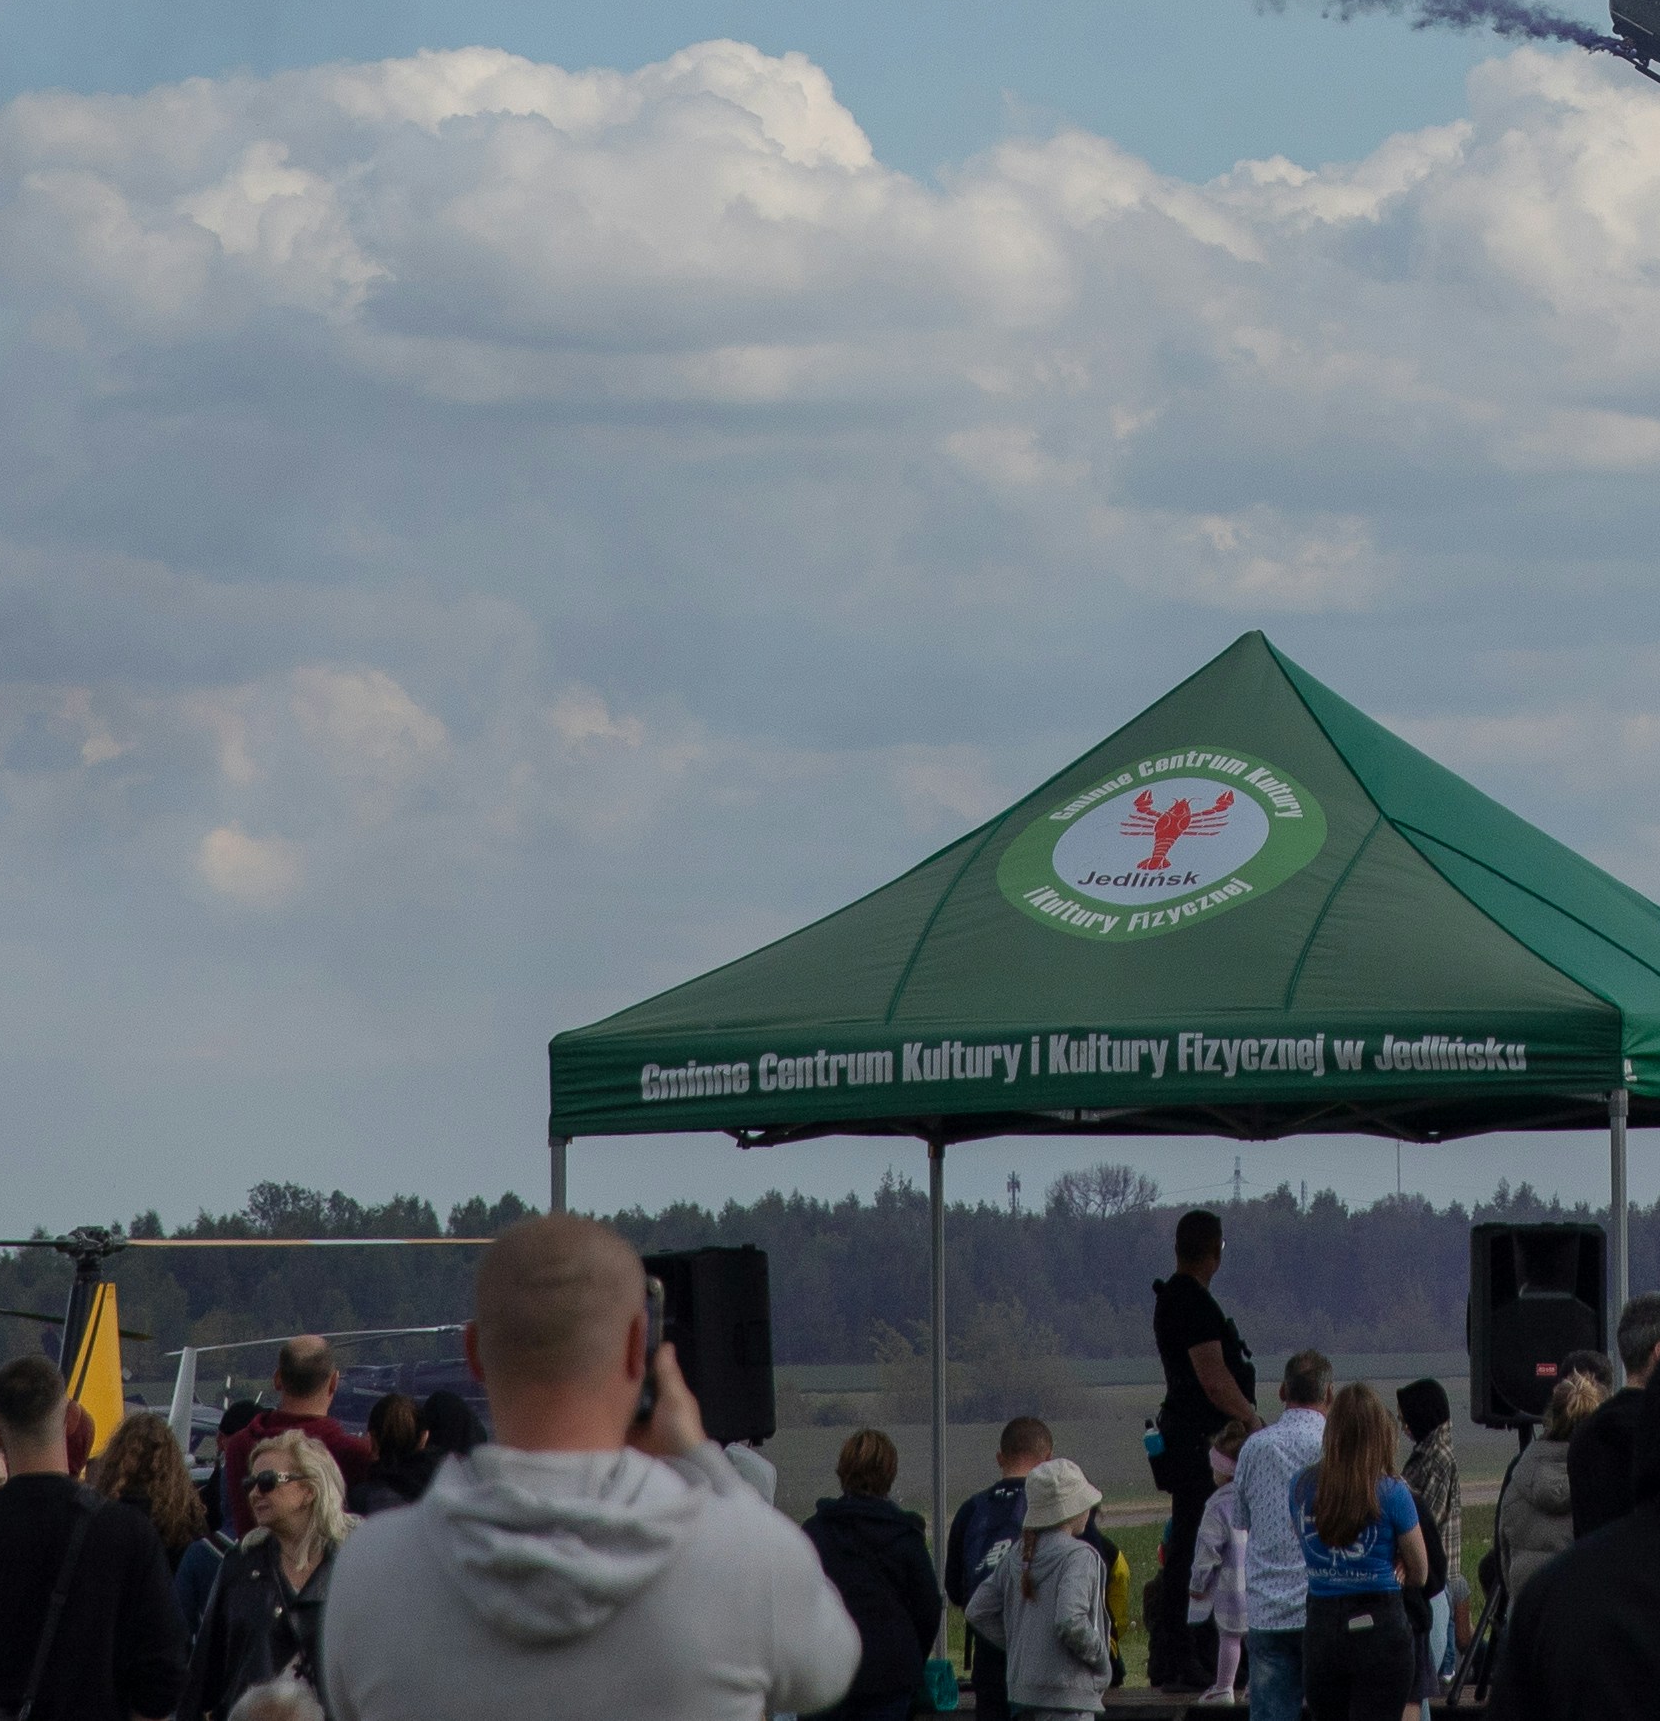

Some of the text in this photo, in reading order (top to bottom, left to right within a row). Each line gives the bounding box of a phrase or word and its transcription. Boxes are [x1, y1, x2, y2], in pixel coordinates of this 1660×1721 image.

[1049, 750, 1303, 821] Gminne Centrum Kultury
[1077, 871, 1201, 888] Jedlińsk
[1127, 877, 1253, 931] Fizycznej
[642, 1032, 1527, 1101] Gminne Centrum Kultury i Kultury Fizycznej w Jedlińsku
